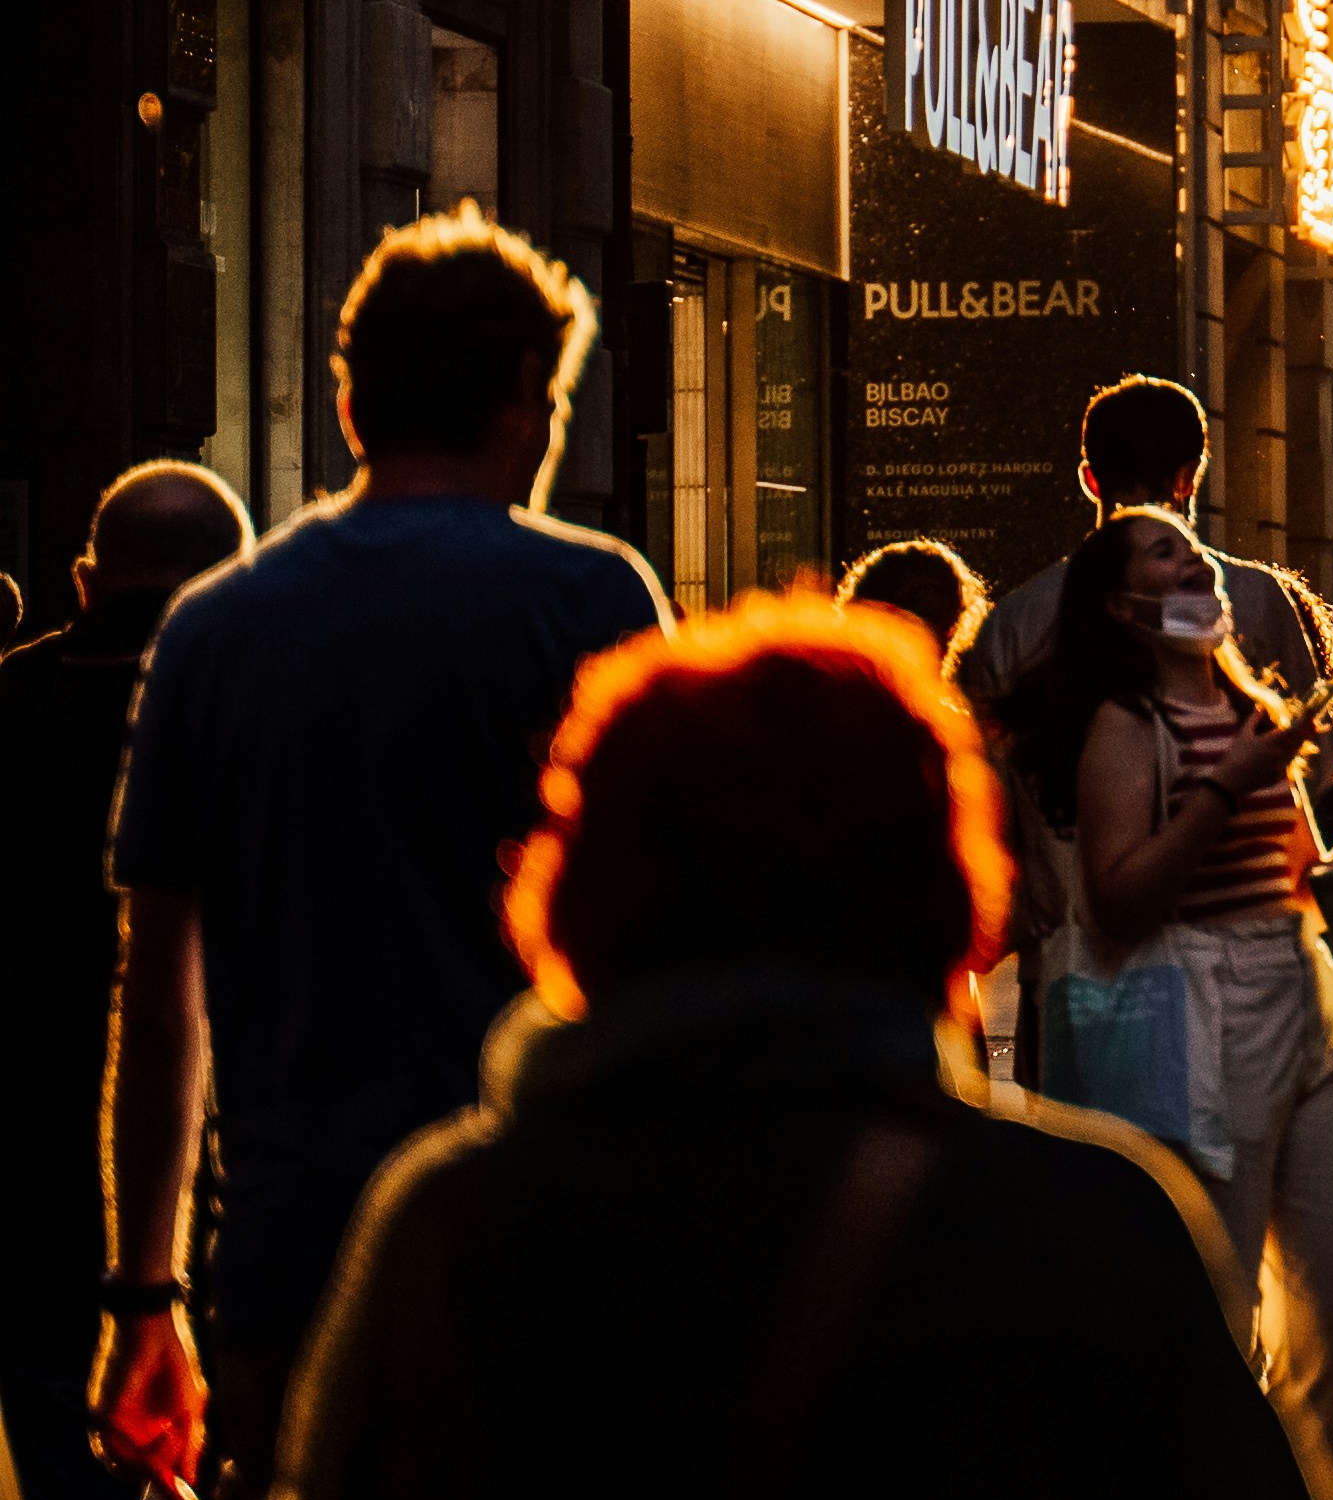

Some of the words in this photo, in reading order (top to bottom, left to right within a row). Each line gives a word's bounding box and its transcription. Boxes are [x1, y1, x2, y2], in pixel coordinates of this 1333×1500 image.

[863, 279, 1100, 320] PULL&BEAR
[866, 407, 949, 427] BISCAY
[885, 463, 935, 476] DIEGO
[908, 484, 974, 497] NAGUSIA
[979, 483, 1011, 496] XVII
[928, 527, 997, 539] COUNTRY
